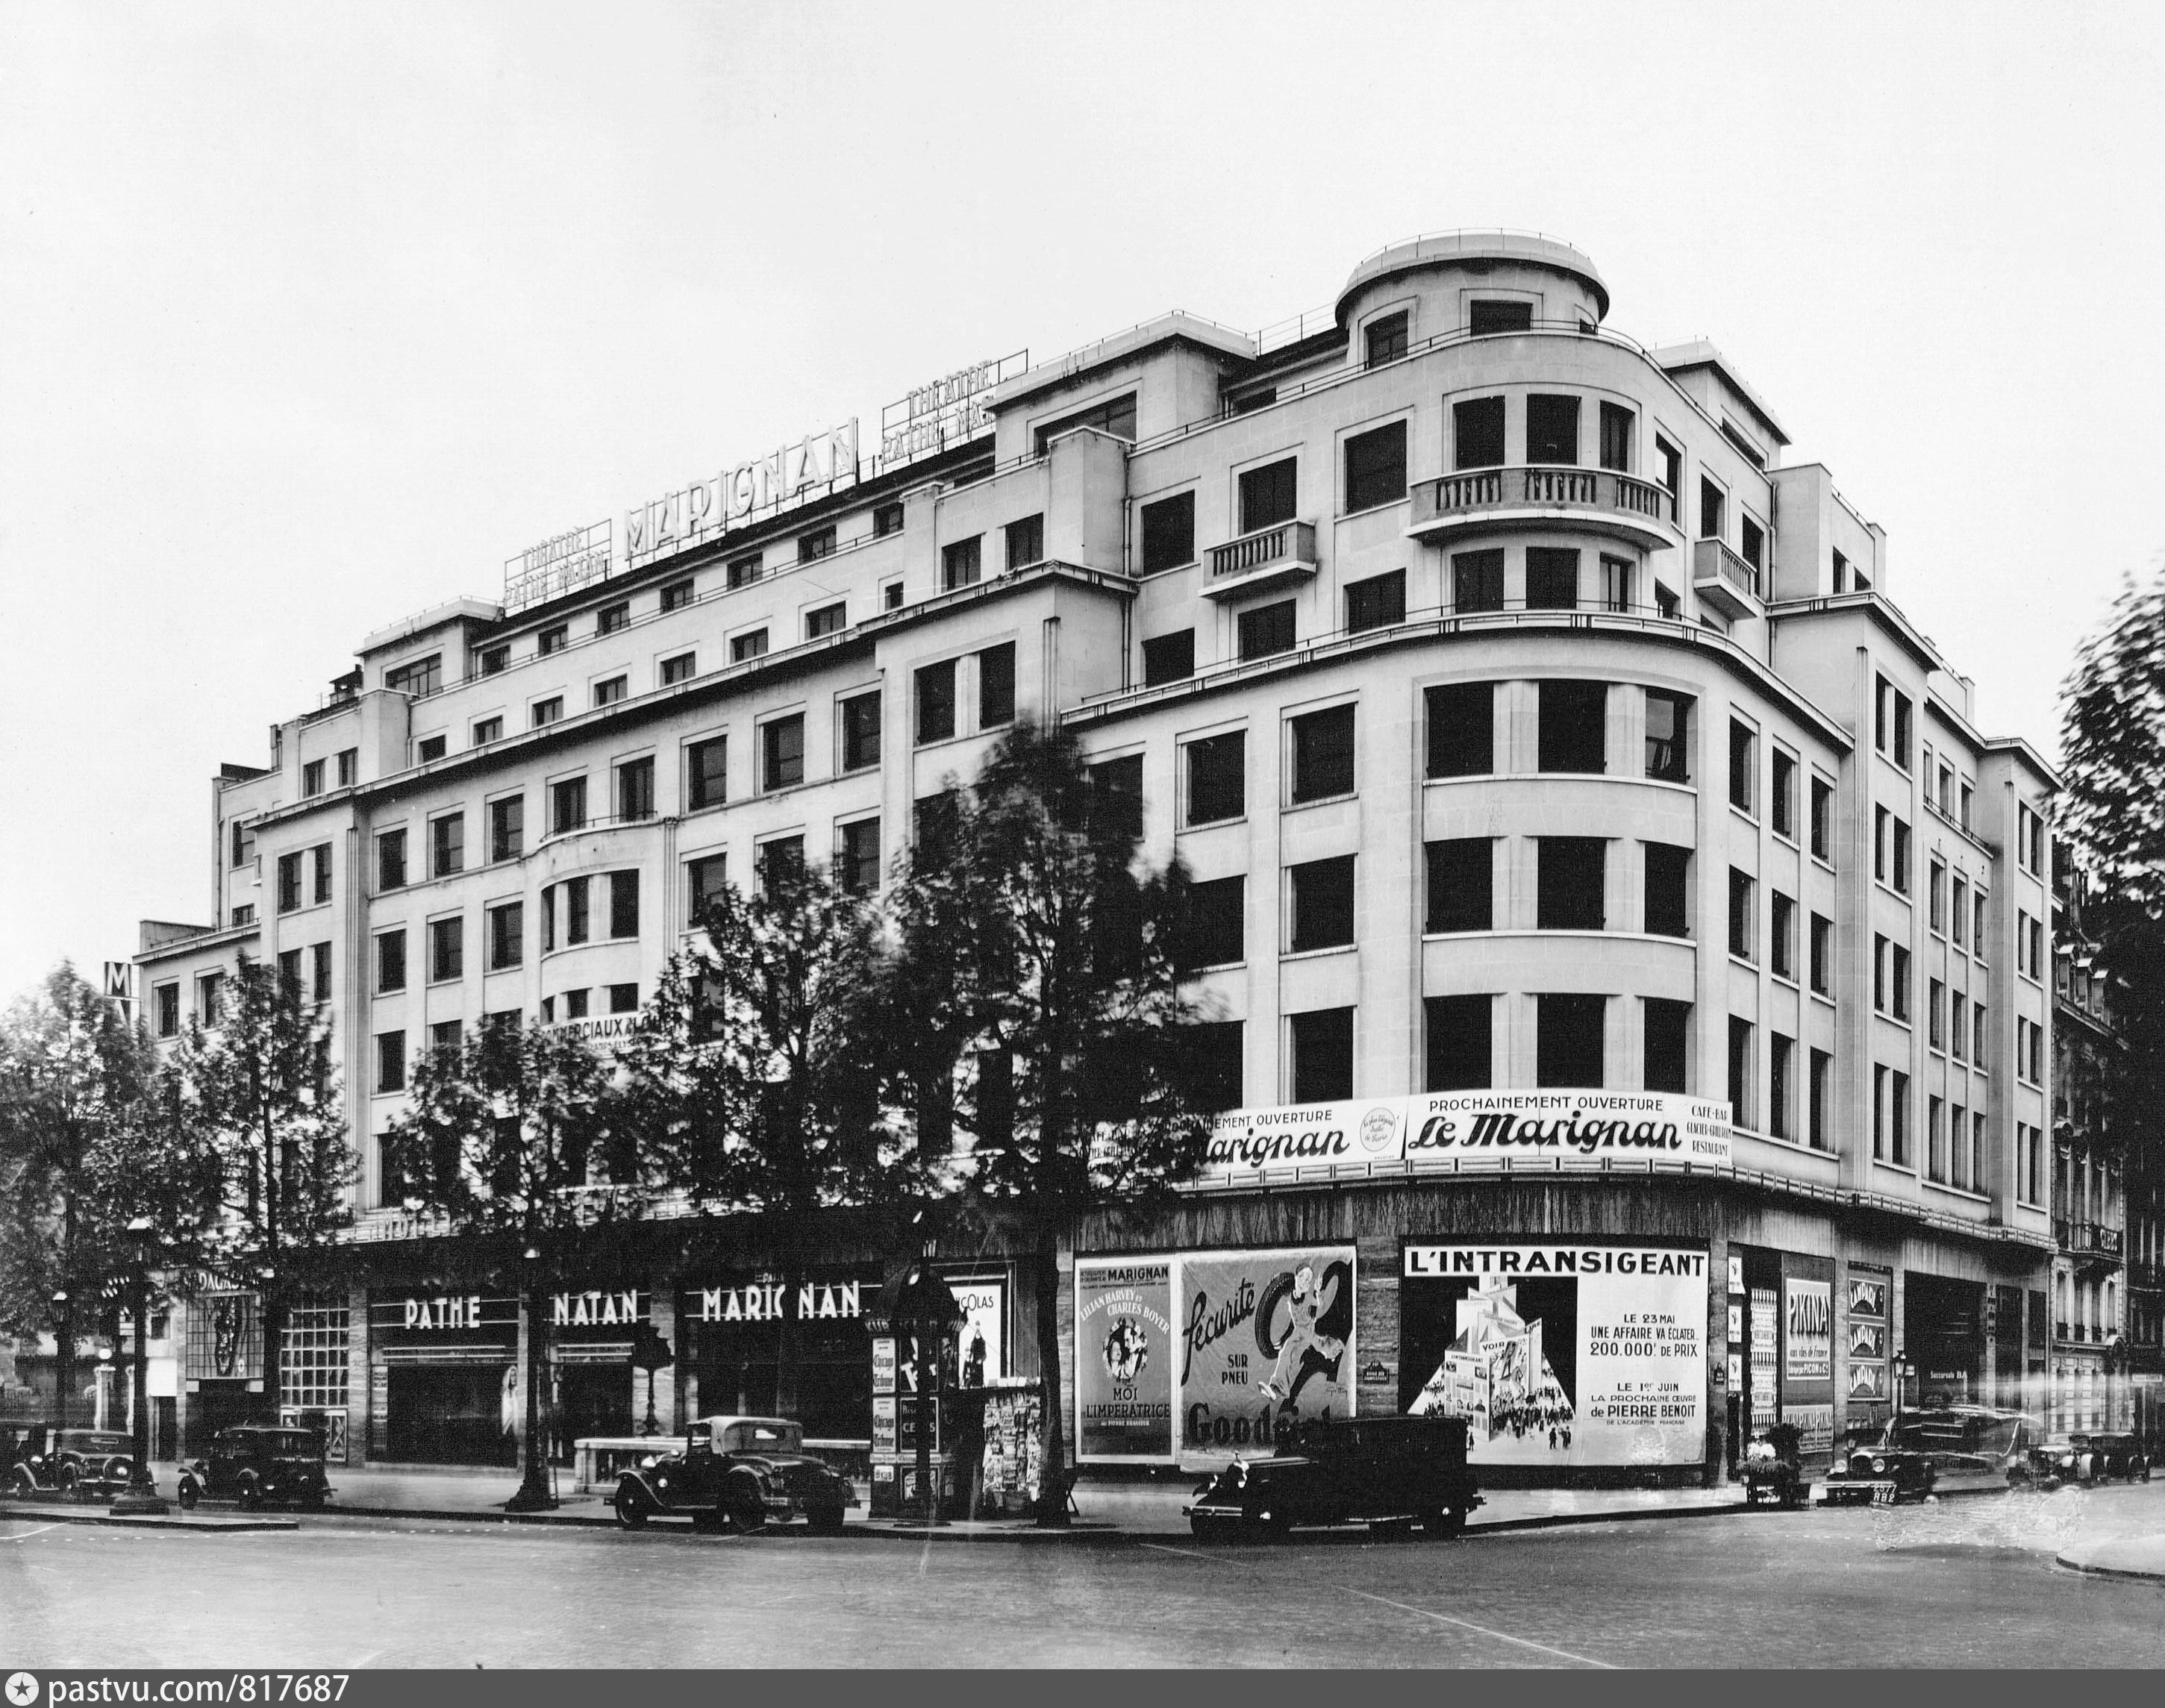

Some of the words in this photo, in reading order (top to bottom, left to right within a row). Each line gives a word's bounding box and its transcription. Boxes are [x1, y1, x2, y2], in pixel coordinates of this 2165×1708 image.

[624, 416, 858, 561] MARIGNAN
[544, 1017, 623, 1044] OMMERCIAUX
[1429, 1096, 1571, 1112] PROCHAINEMENT
[1578, 1096, 1663, 1112] OUVERTURE
[1257, 1109, 1333, 1126] OUVERTURE
[1408, 1116, 1456, 1150] Le
[1460, 1110, 1682, 1154] Marignan
[1203, 1127, 1350, 1169] arignan
[1692, 1139, 1728, 1157] RESTAURANT
[1410, 1251, 1705, 1277] L'INTRANSIGEANT
[1108, 1266, 1169, 1281] MARIGNAN
[405, 1296, 480, 1329] PATHE
[554, 1289, 637, 1326] NATAN
[955, 1294, 994, 1311] ICOLAS
[1080, 1295, 1105, 1321] LILIAN
[1105, 1289, 1136, 1304] HARVEY
[1107, 1301, 1142, 1316] CHARLES
[1143, 1306, 1169, 1334] BOYER
[1624, 1314, 1637, 1323] LE
[1643, 1314, 1658, 1324] 23
[1660, 1315, 1675, 1324] MAI
[1790, 1292, 1830, 1333] PIKINA
[1591, 1326, 1609, 1339] UNE
[1613, 1327, 1652, 1339] AFFAIRE
[1656, 1327, 1665, 1339] VA
[1661, 1346, 1671, 1357] DE
[1675, 1343, 1698, 1357] PRIX
[1228, 1354, 1248, 1368] SUR
[1221, 1371, 1249, 1386] PNEU
[1113, 1387, 1137, 1401] MOI
[1617, 1383, 1632, 1392] LE
[1658, 1383, 1679, 1392] JUIN
[1086, 1403, 1170, 1418] L'IMPERATRICE
[1590, 1407, 1605, 1418] de
[1608, 1404, 1657, 1418] PIERRE
[1661, 1405, 1696, 1418] BENOIT
[1873, 1492, 1896, 1503] RB2
